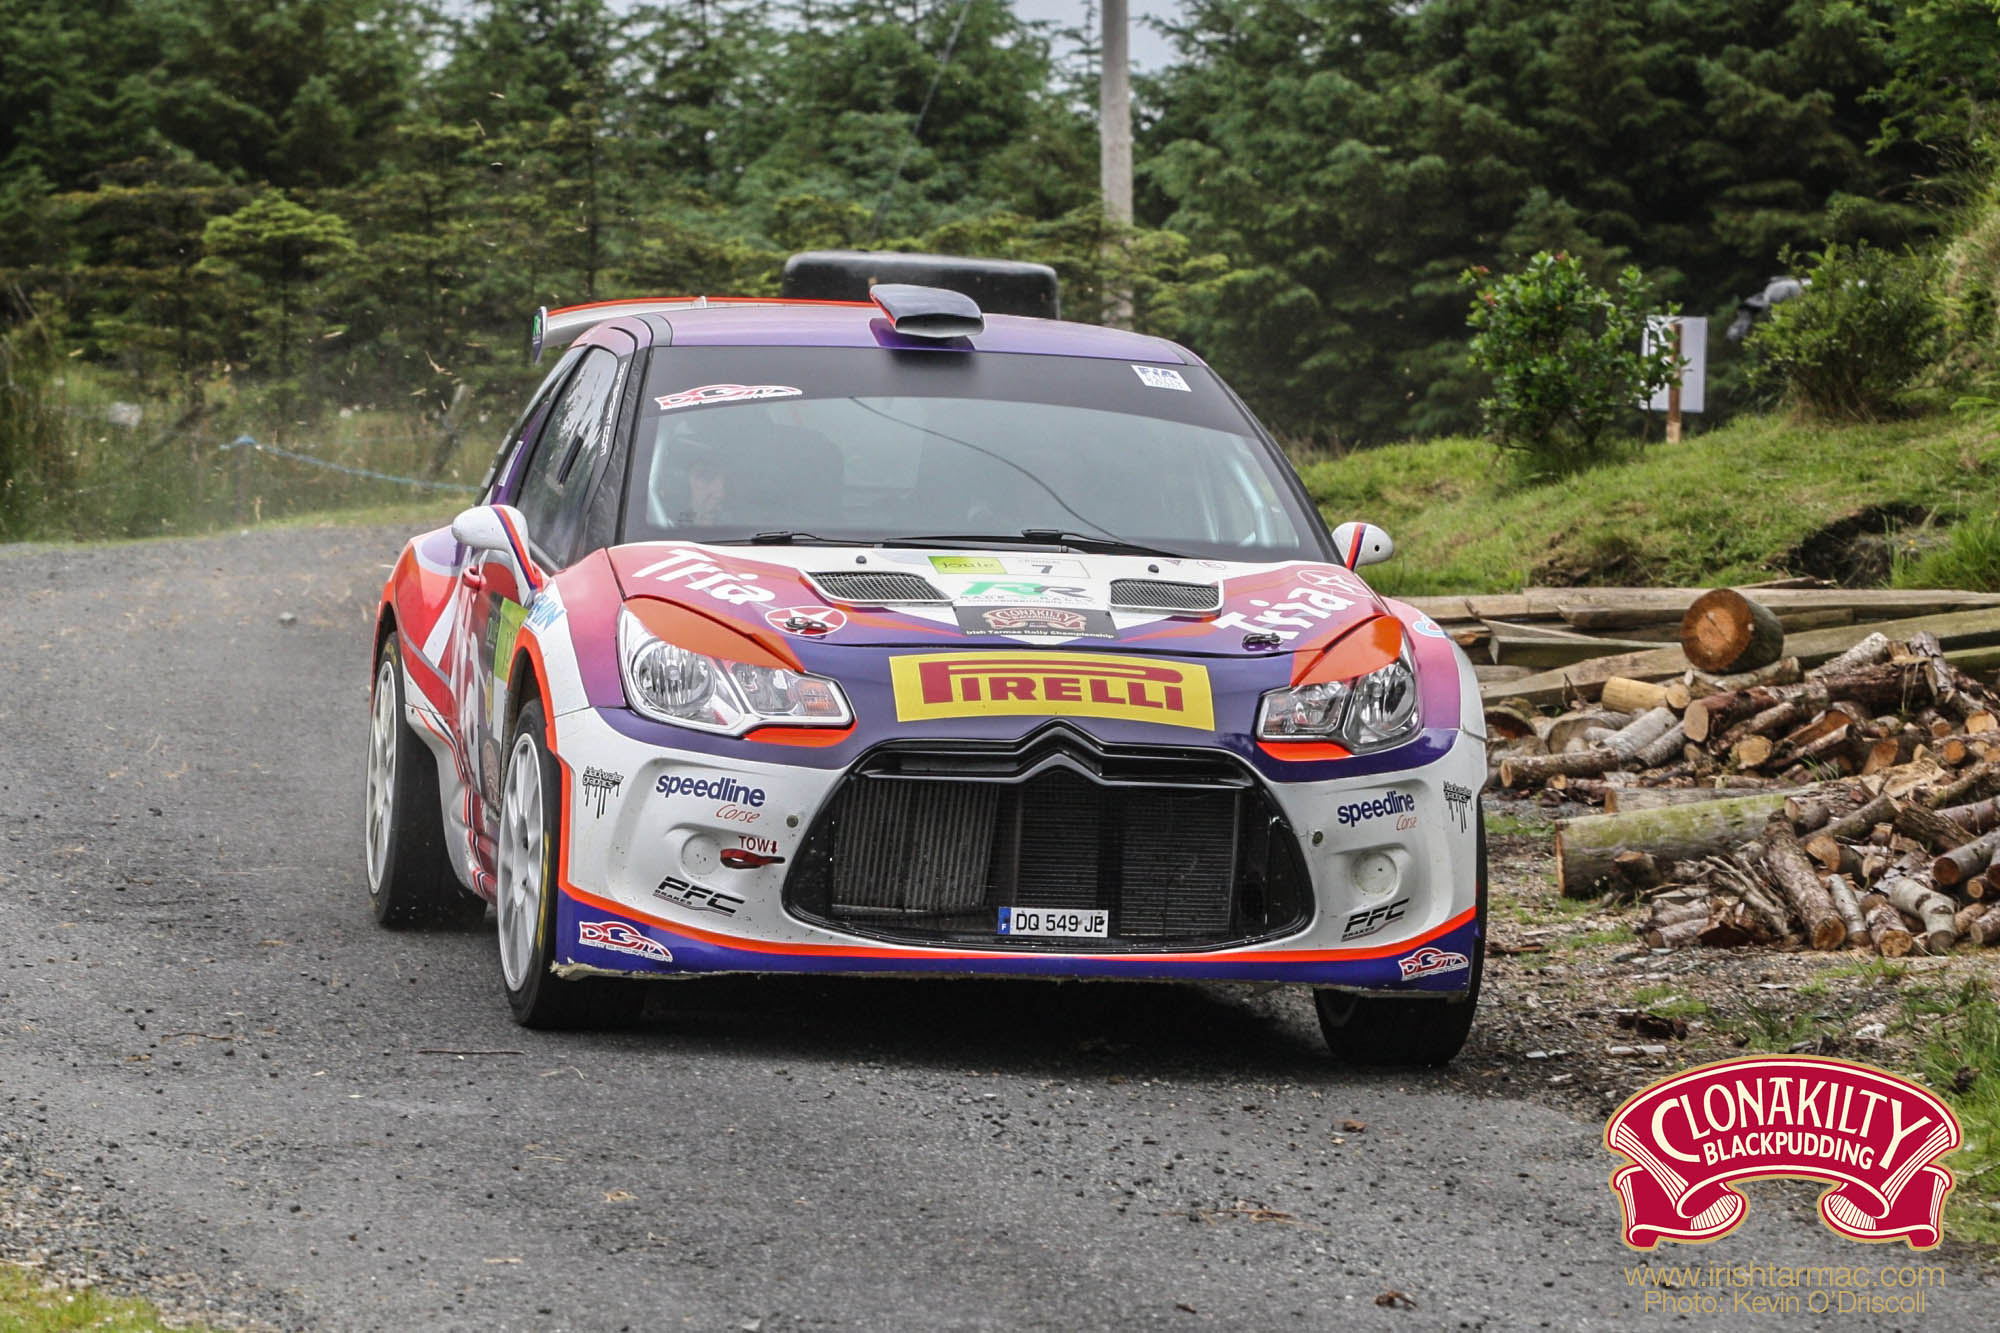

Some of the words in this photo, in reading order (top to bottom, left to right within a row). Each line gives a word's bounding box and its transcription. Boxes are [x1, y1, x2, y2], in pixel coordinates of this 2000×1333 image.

[632, 549, 775, 605] Tria
[1031, 565, 1053, 574] 7
[918, 659, 1184, 712] PIRELLI
[656, 775, 765, 807] speedline
[716, 804, 760, 823] Corse
[1337, 790, 1415, 827] speedline
[1395, 815, 1417, 831] Corse
[738, 835, 770, 852] TOW
[658, 876, 745, 913] PFC
[1016, 913, 1039, 931] DQ
[1046, 914, 1078, 932] 549
[1343, 897, 1410, 932] PFC
